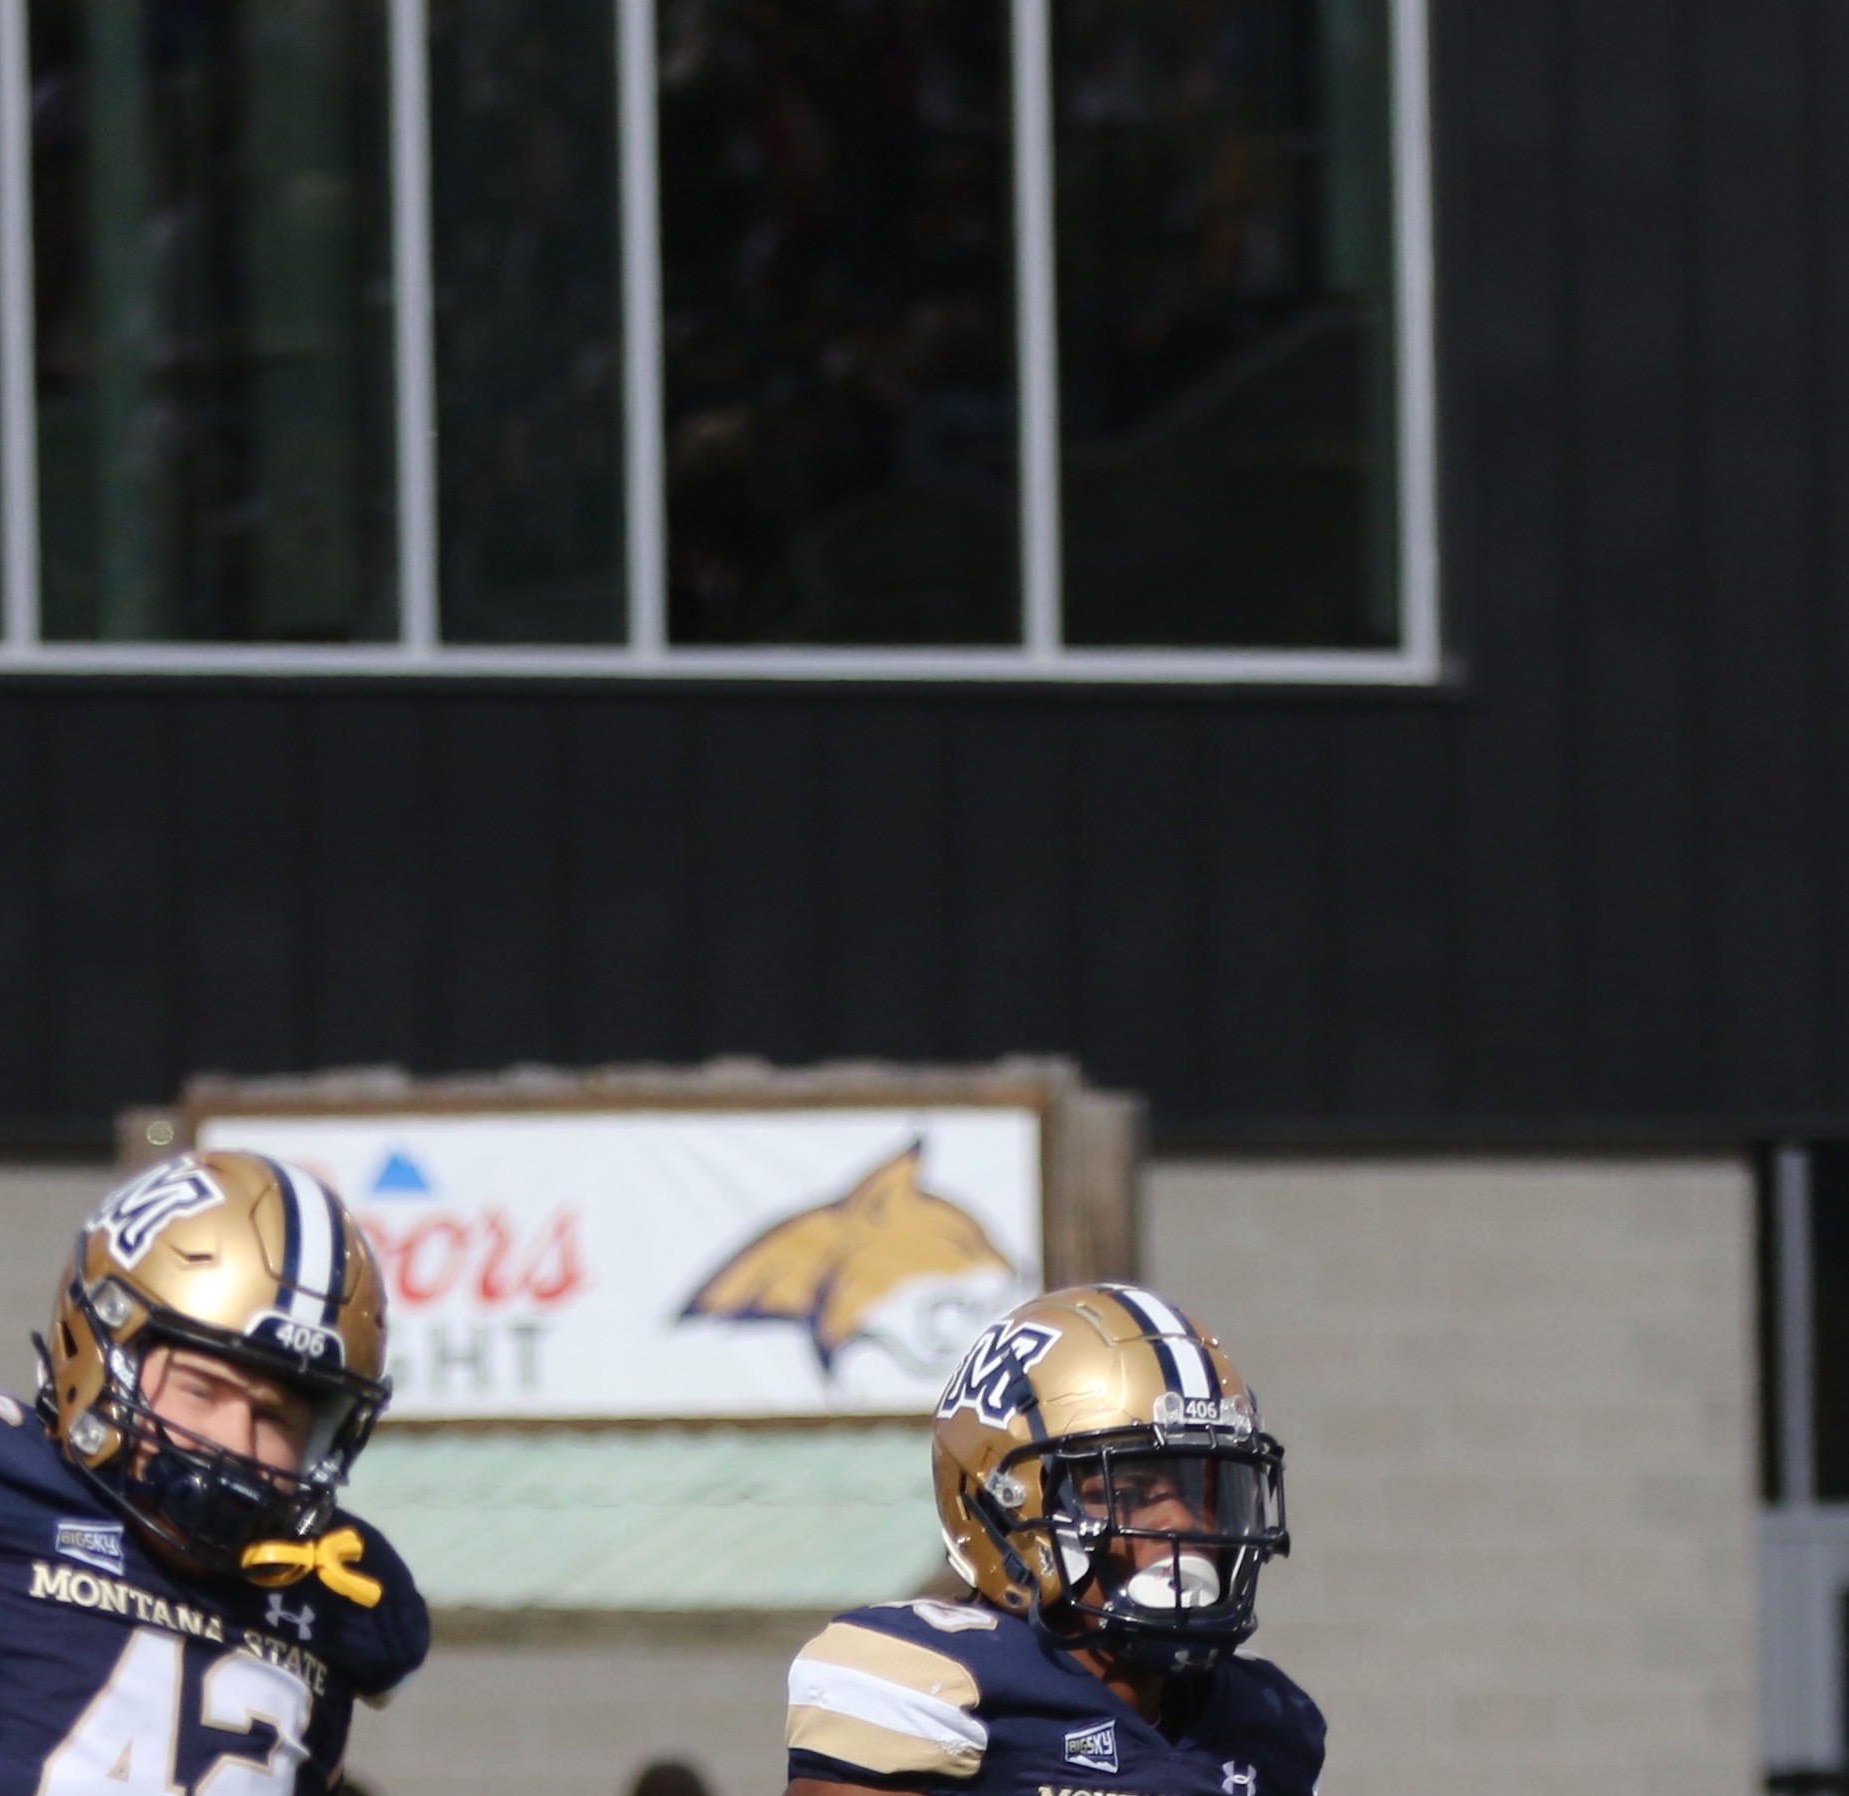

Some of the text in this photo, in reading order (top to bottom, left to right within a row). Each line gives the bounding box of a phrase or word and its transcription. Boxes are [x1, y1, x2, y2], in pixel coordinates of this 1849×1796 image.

[275, 1323, 327, 1357] 406
[1184, 1400, 1219, 1420] 406
[28, 1560, 329, 1698] MONTANA STATE
